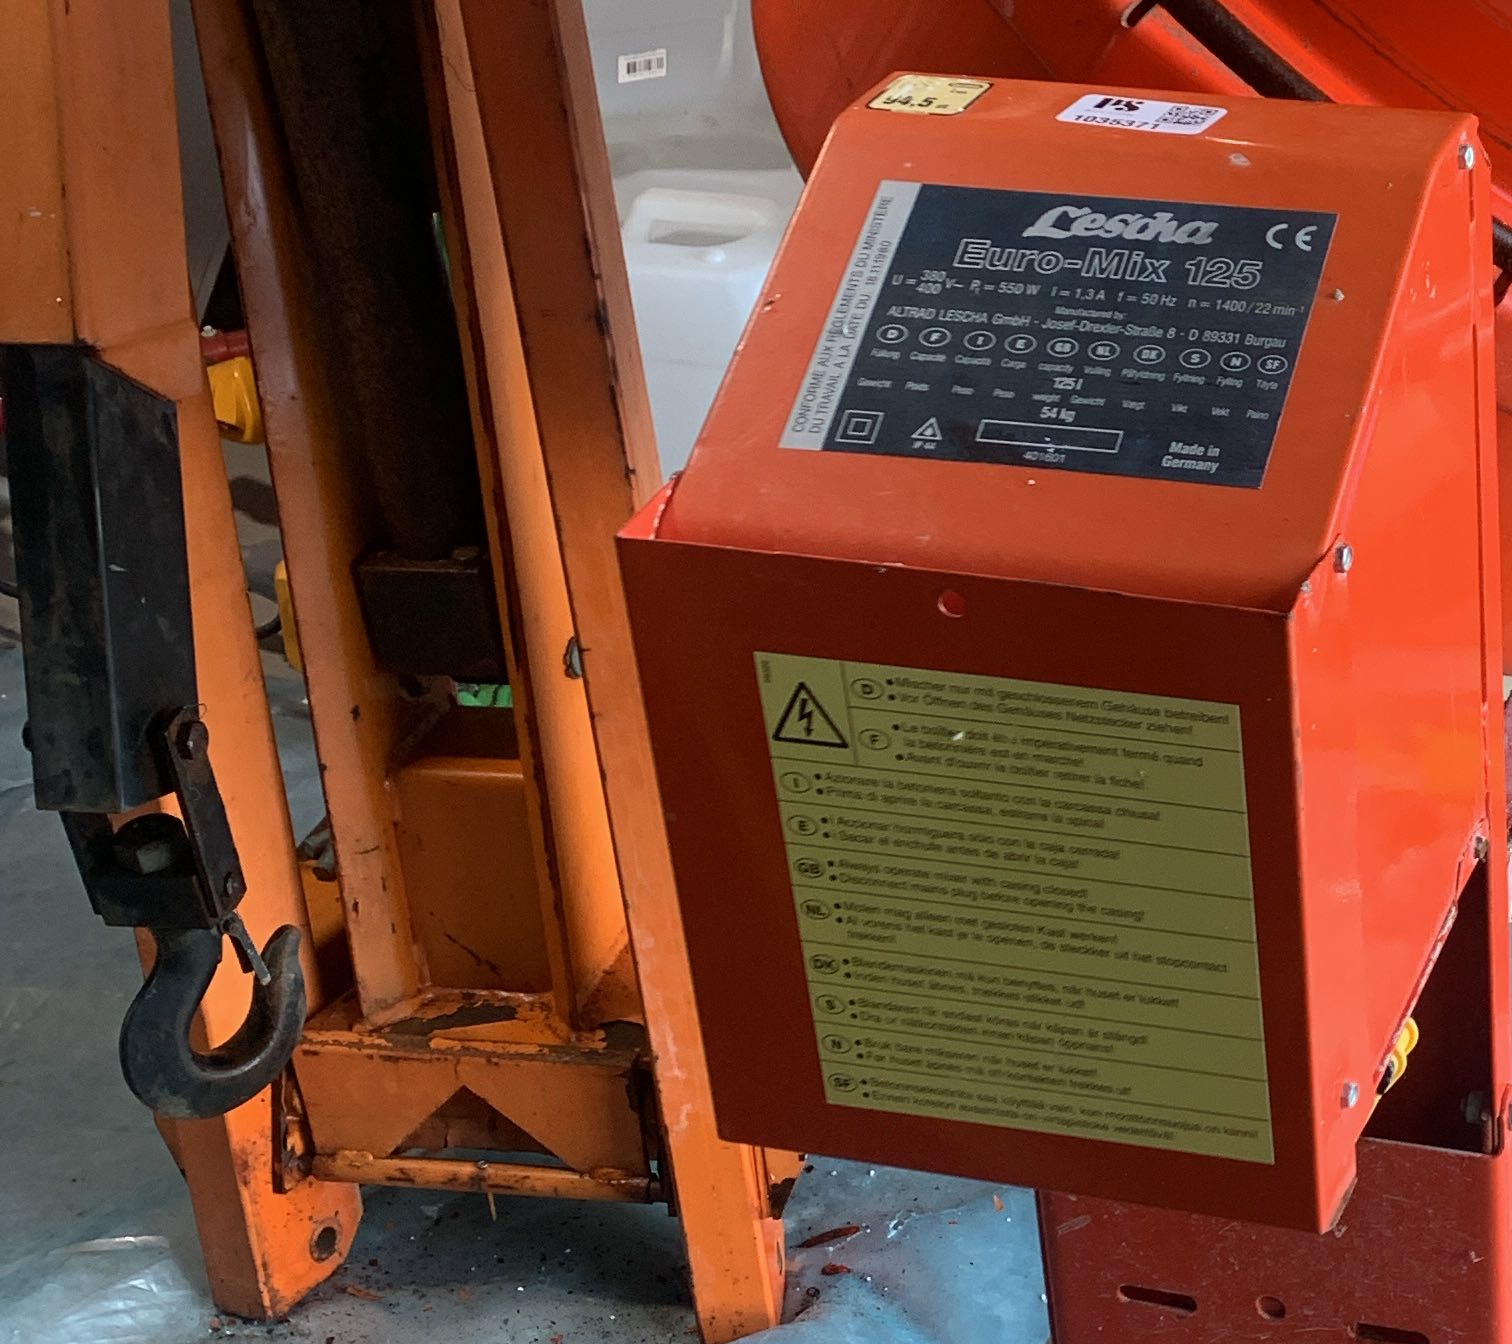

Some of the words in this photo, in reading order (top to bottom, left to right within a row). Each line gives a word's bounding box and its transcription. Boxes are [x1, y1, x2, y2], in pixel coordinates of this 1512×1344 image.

[1073, 113, 1162, 130] 1035371
[1022, 205, 1219, 246] Lescha
[952, 238, 1170, 283] Euro-Mix
[1185, 257, 1262, 289] 125
[937, 308, 990, 323] LESCHA
[989, 313, 1032, 327] GmbH
[1201, 330, 1241, 344] 89331
[1242, 334, 1288, 350] Burgau
[1167, 441, 1206, 455] Made
[1205, 444, 1221, 457] in
[1159, 455, 1220, 473] Germany
